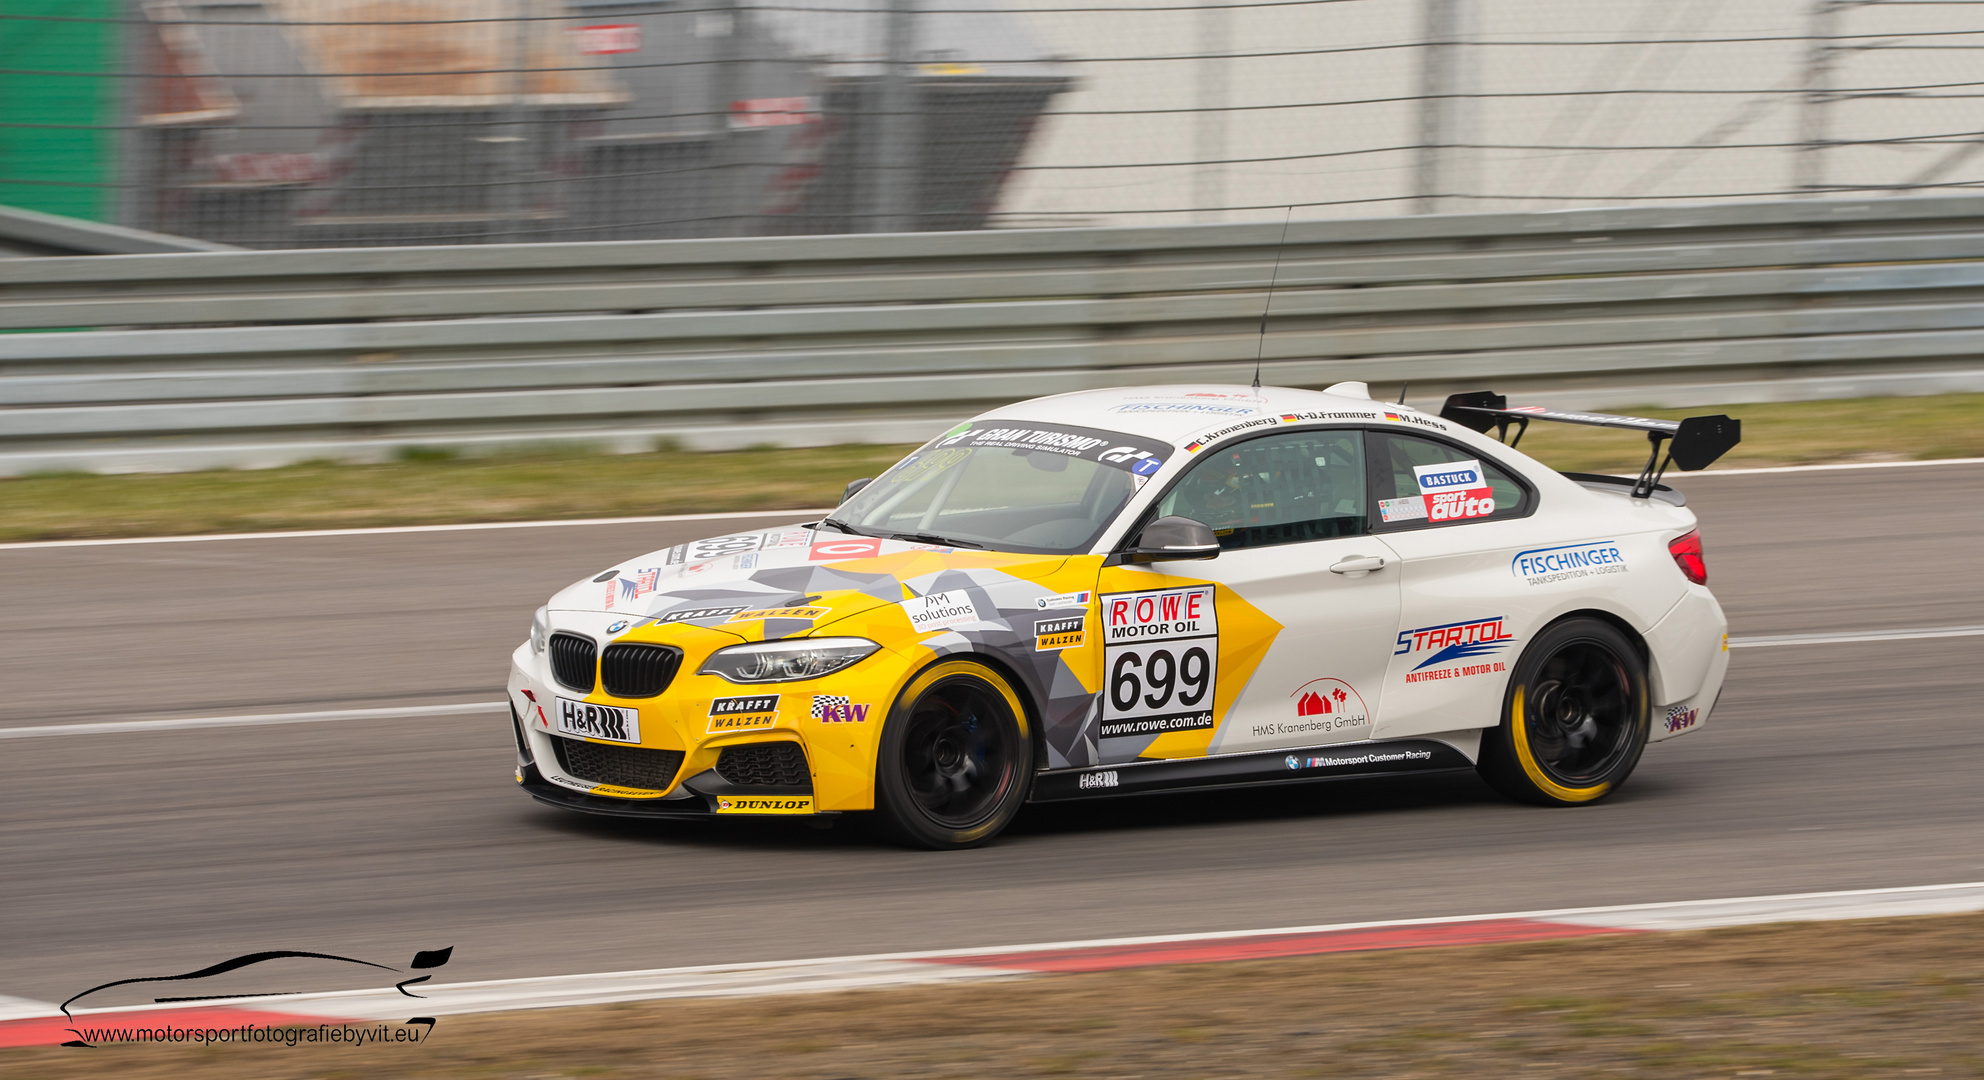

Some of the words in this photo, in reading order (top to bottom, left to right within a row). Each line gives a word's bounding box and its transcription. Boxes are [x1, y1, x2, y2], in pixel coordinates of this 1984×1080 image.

[1119, 404, 1254, 415] FISCHINGER
[1399, 414, 1448, 431] M.Hess
[976, 429, 1031, 441] GRAN
[1196, 417, 1278, 446] C.Kranenberg
[1004, 441, 1036, 450] DRIVING
[1036, 444, 1080, 457] SIMULATOR
[1426, 472, 1472, 486] BASTUCK
[1432, 490, 1467, 505] sport
[1431, 497, 1496, 520] auto
[1520, 548, 1624, 576] FISCHINGER
[1527, 569, 1588, 586] TANKSPEDITION
[1595, 564, 1628, 575] LOGISTIK
[666, 607, 743, 622] KRAFFT
[739, 608, 819, 619] WALZEN
[912, 604, 973, 624] solutions
[1110, 592, 1203, 627] ROWE
[1040, 621, 1079, 633] KRAFFT
[1111, 623, 1170, 639] MOTOR
[1174, 621, 1200, 633] OIL
[1041, 634, 1082, 646] WALZEN
[1394, 620, 1513, 656] STARTOL
[1110, 646, 1211, 712] 699
[1405, 668, 1452, 684] ANTIFREEZE
[1453, 667, 1461, 678] &
[1462, 664, 1492, 677] MOTOR
[1493, 661, 1507, 672] OIL
[716, 699, 772, 712] KRAFFT
[821, 704, 870, 724] KW
[714, 715, 773, 728] WALZEN
[1100, 712, 1213, 736] www.rowe.com.de
[1252, 723, 1276, 737] HMS
[1277, 719, 1332, 734] Kranenberg
[1334, 714, 1366, 729] GmbH
[1325, 755, 1369, 767] Motorsport
[1368, 753, 1406, 763] Customer
[1405, 750, 1432, 760] Racing
[734, 800, 810, 809] DUNLOP
